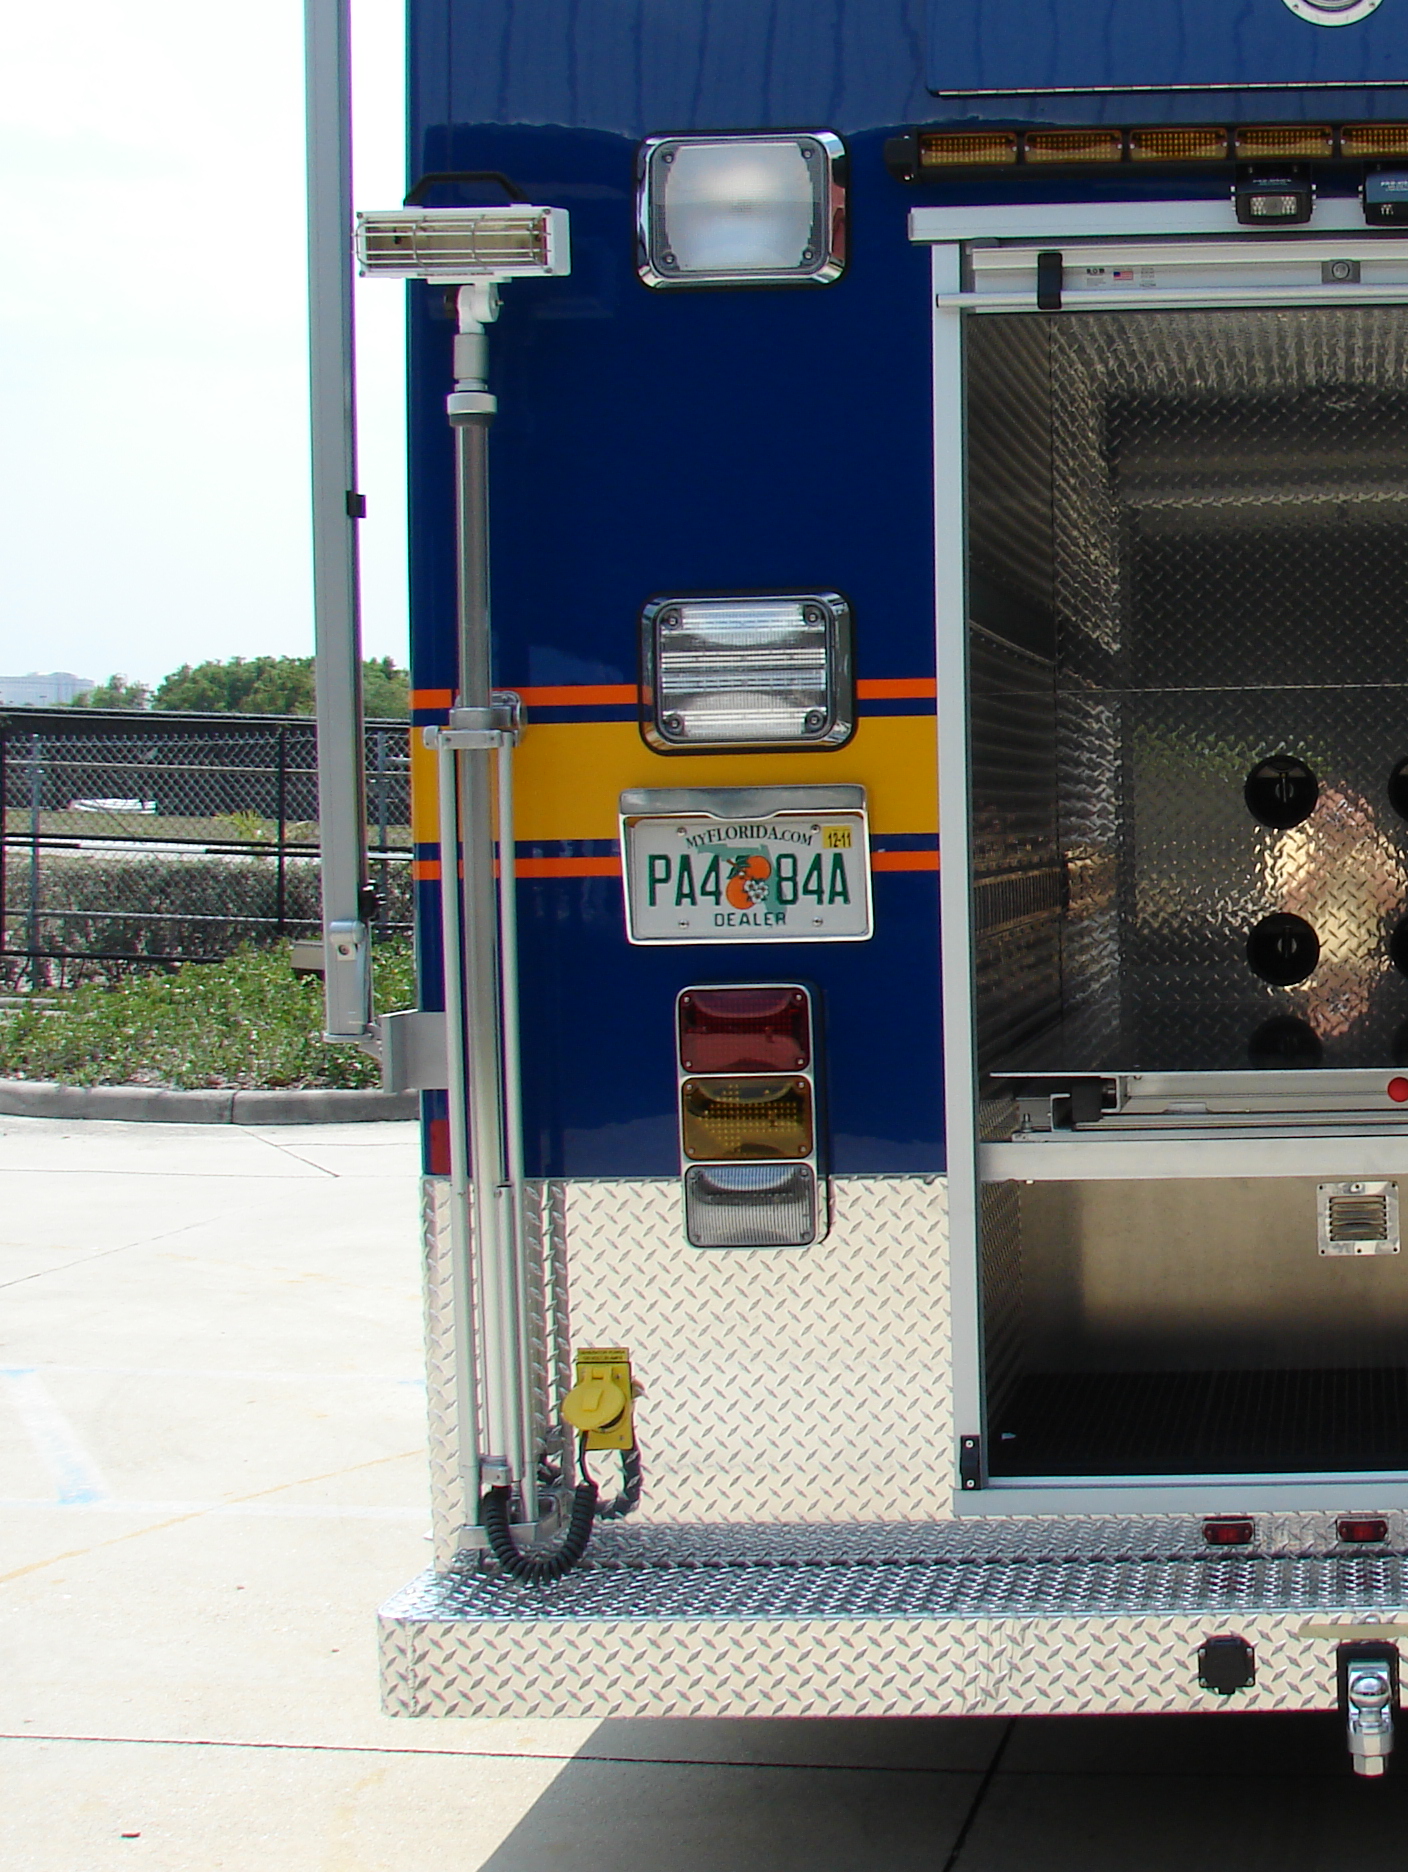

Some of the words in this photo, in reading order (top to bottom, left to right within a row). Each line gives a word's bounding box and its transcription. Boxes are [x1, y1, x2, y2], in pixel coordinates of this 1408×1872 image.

[685, 824, 814, 850] MYFLORIDA.COM
[648, 854, 723, 907] PA4
[776, 852, 851, 906] 84A
[714, 911, 787, 928] DEALER
